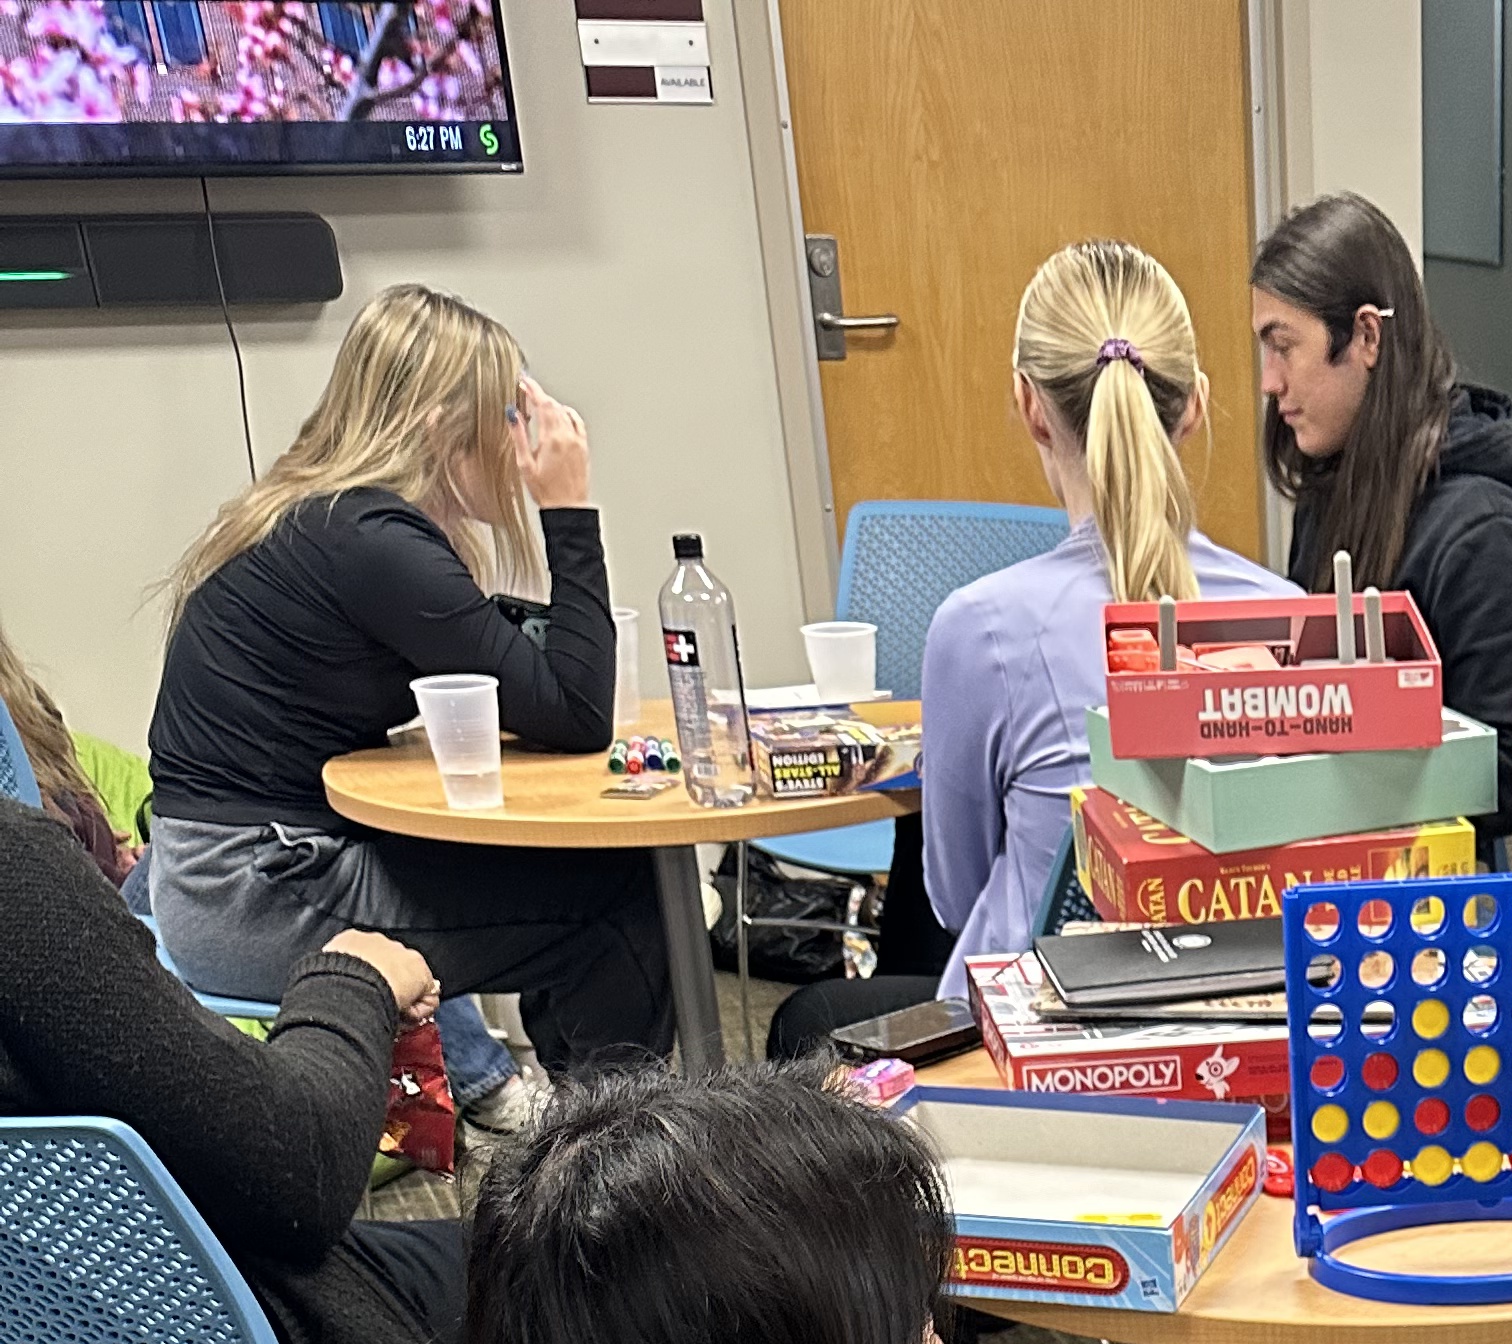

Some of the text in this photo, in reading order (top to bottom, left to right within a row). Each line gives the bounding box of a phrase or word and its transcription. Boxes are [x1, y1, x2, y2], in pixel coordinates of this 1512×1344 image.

[661, 77, 706, 88] AVAILABLE
[405, 125, 462, 151] 6:27 PM
[1198, 684, 1354, 721] WOMBAT
[1200, 716, 1353, 740] HAND-TO-HAND
[772, 752, 826, 767] EDITION
[1146, 876, 1166, 927] ATAN
[1030, 1061, 1176, 1093] MONOPOLY
[955, 1247, 1115, 1285] Connect
